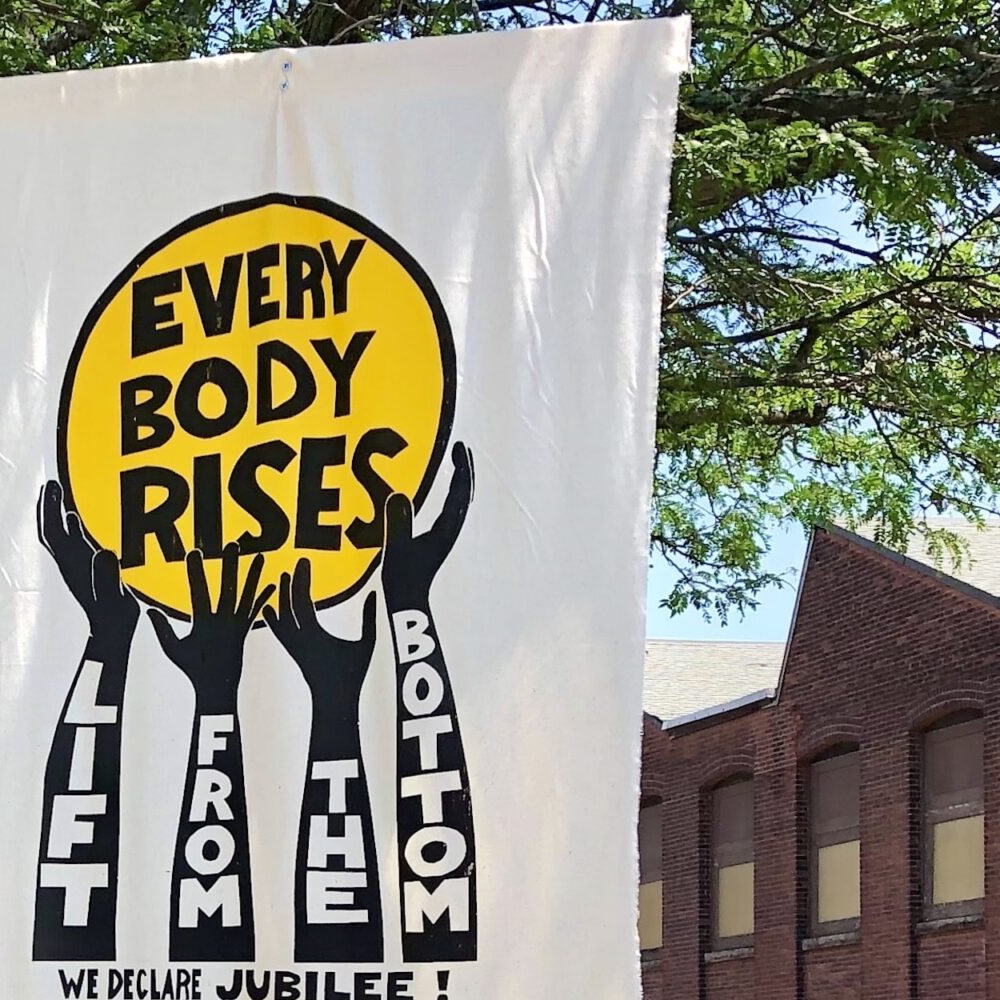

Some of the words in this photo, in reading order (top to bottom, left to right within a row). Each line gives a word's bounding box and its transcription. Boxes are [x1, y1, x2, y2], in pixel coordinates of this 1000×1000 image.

[131, 238, 367, 359] EVERY
[120, 330, 377, 457] BODY
[119, 427, 409, 570] RISES
[39, 659, 118, 927] LIFT
[178, 713, 242, 928] FROM
[306, 758, 369, 925] THE
[391, 609, 470, 934] BOTTOM
[58, 968, 99, 1000] WE
[107, 968, 202, 1000] DECLARE
